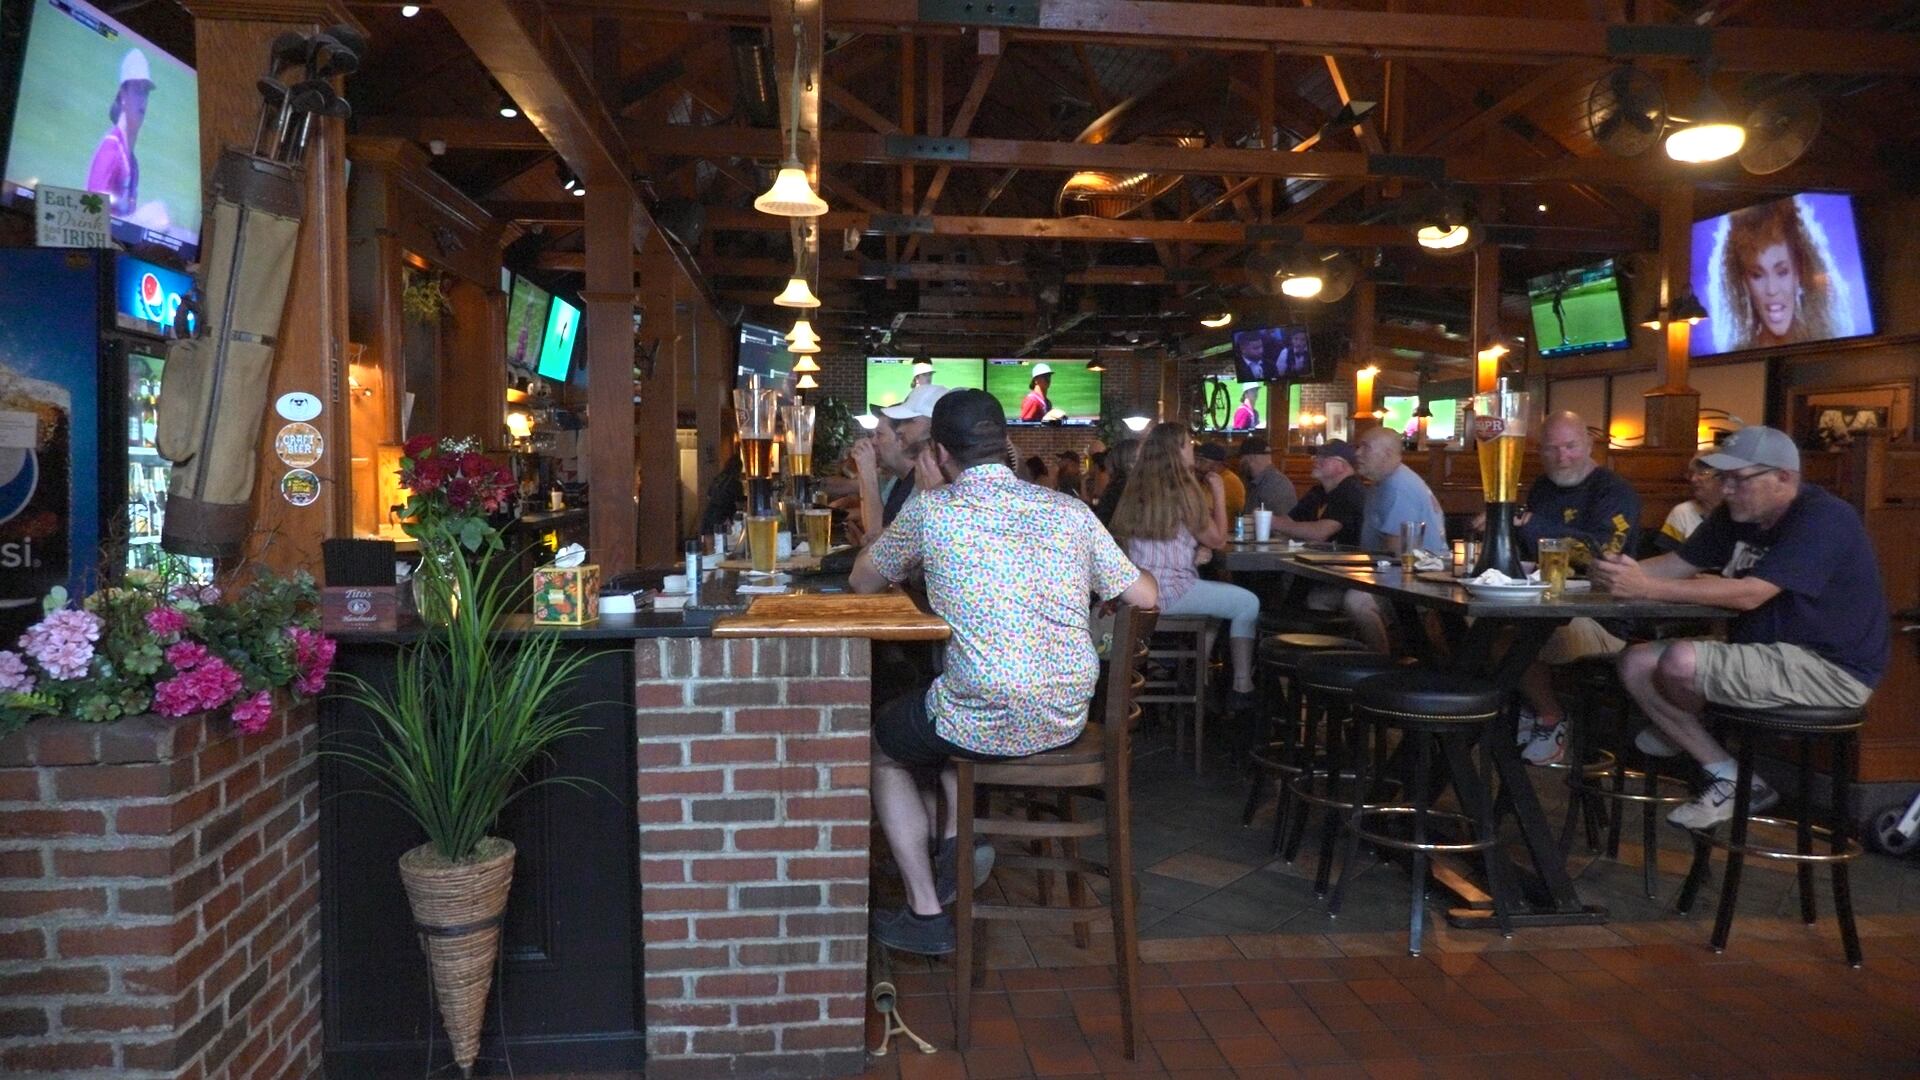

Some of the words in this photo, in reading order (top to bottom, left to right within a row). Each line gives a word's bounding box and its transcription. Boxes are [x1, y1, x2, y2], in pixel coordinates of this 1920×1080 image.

[62, 227, 106, 249] IRISH
[282, 434, 315, 446] CRAFT
[287, 443, 312, 454] BEER
[345, 588, 374, 599] Tito's
